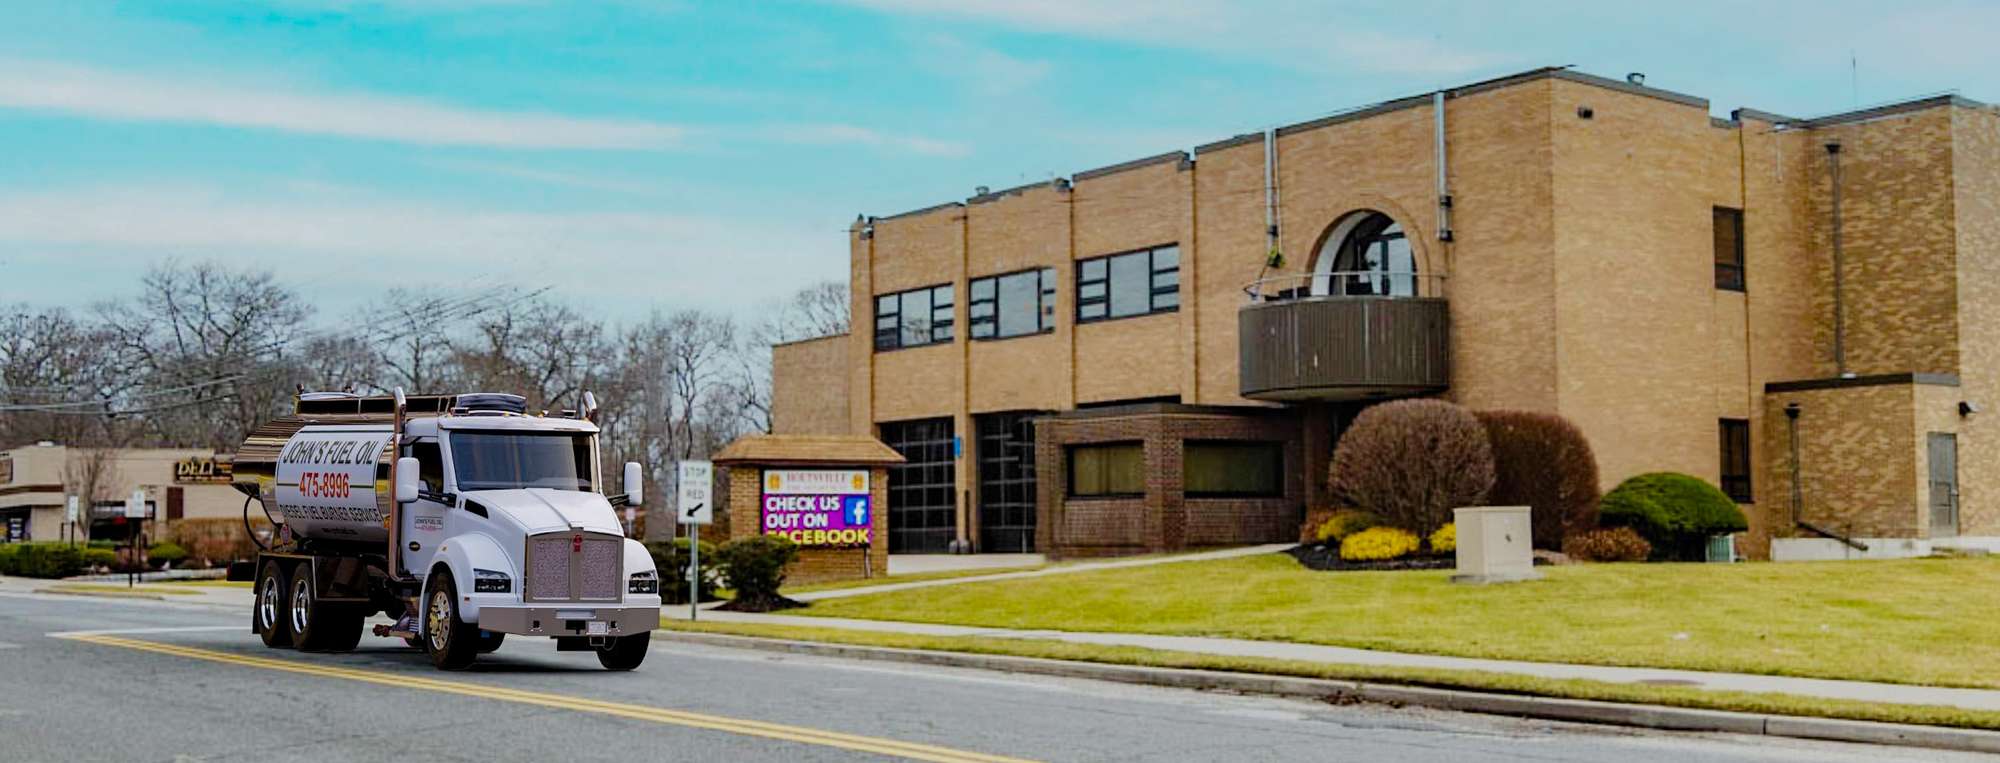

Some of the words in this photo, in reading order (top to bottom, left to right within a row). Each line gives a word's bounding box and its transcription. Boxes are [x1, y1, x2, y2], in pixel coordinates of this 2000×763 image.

[283, 441, 329, 464] JOHN'S
[324, 441, 358, 464] FUEL
[355, 441, 379, 465] OIL
[178, 460, 214, 475] DELI
[684, 466, 707, 478] STOP
[299, 472, 350, 498] 475-8996
[687, 490, 705, 500] RED
[766, 496, 816, 512] CHECK
[820, 496, 840, 511] US
[302, 505, 325, 519] FUEL
[320, 506, 353, 521] BURNER
[349, 506, 382, 522] SERVICE
[766, 513, 800, 528] OUT
[803, 513, 829, 528] ON
